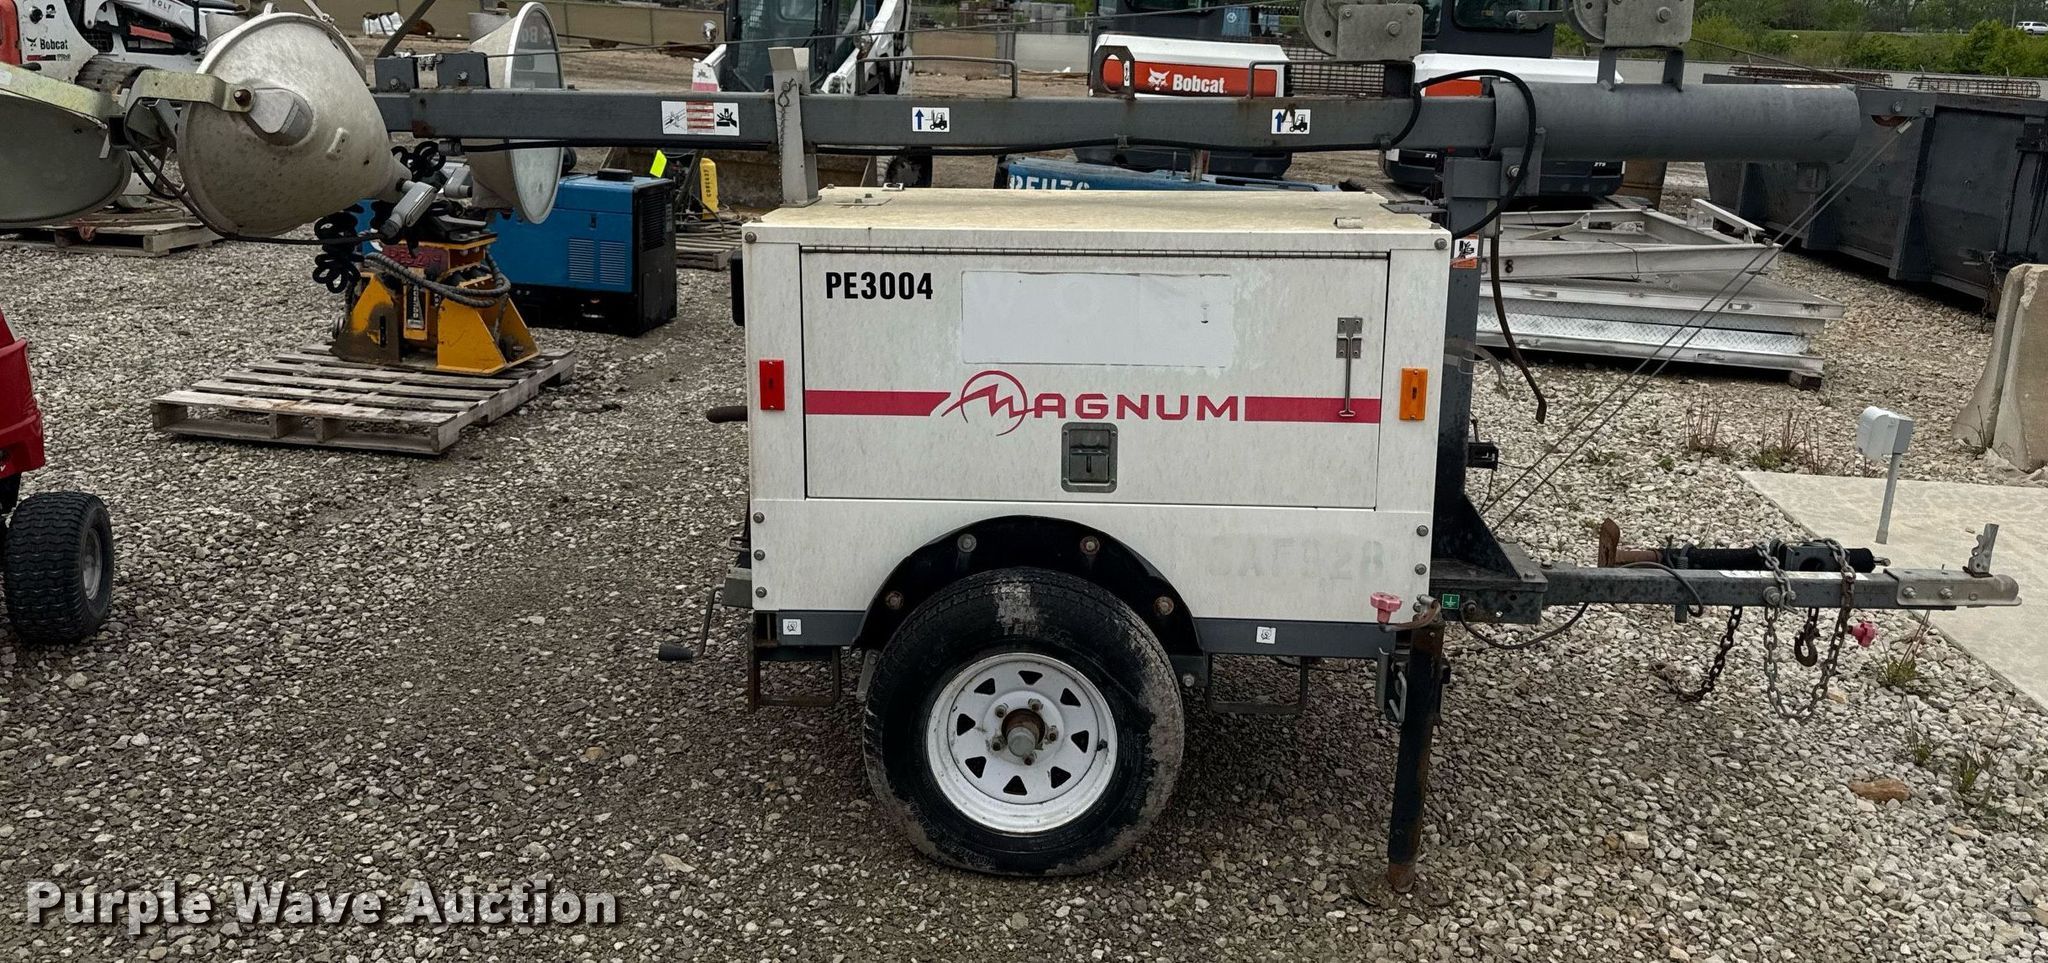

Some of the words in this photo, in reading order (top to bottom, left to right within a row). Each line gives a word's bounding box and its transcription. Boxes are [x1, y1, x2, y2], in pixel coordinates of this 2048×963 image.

[40, 38, 69, 50] Bobcat
[1172, 74, 1225, 94] Bobcat
[825, 271, 934, 300] PE3004
[942, 372, 1238, 432] MAGNUM
